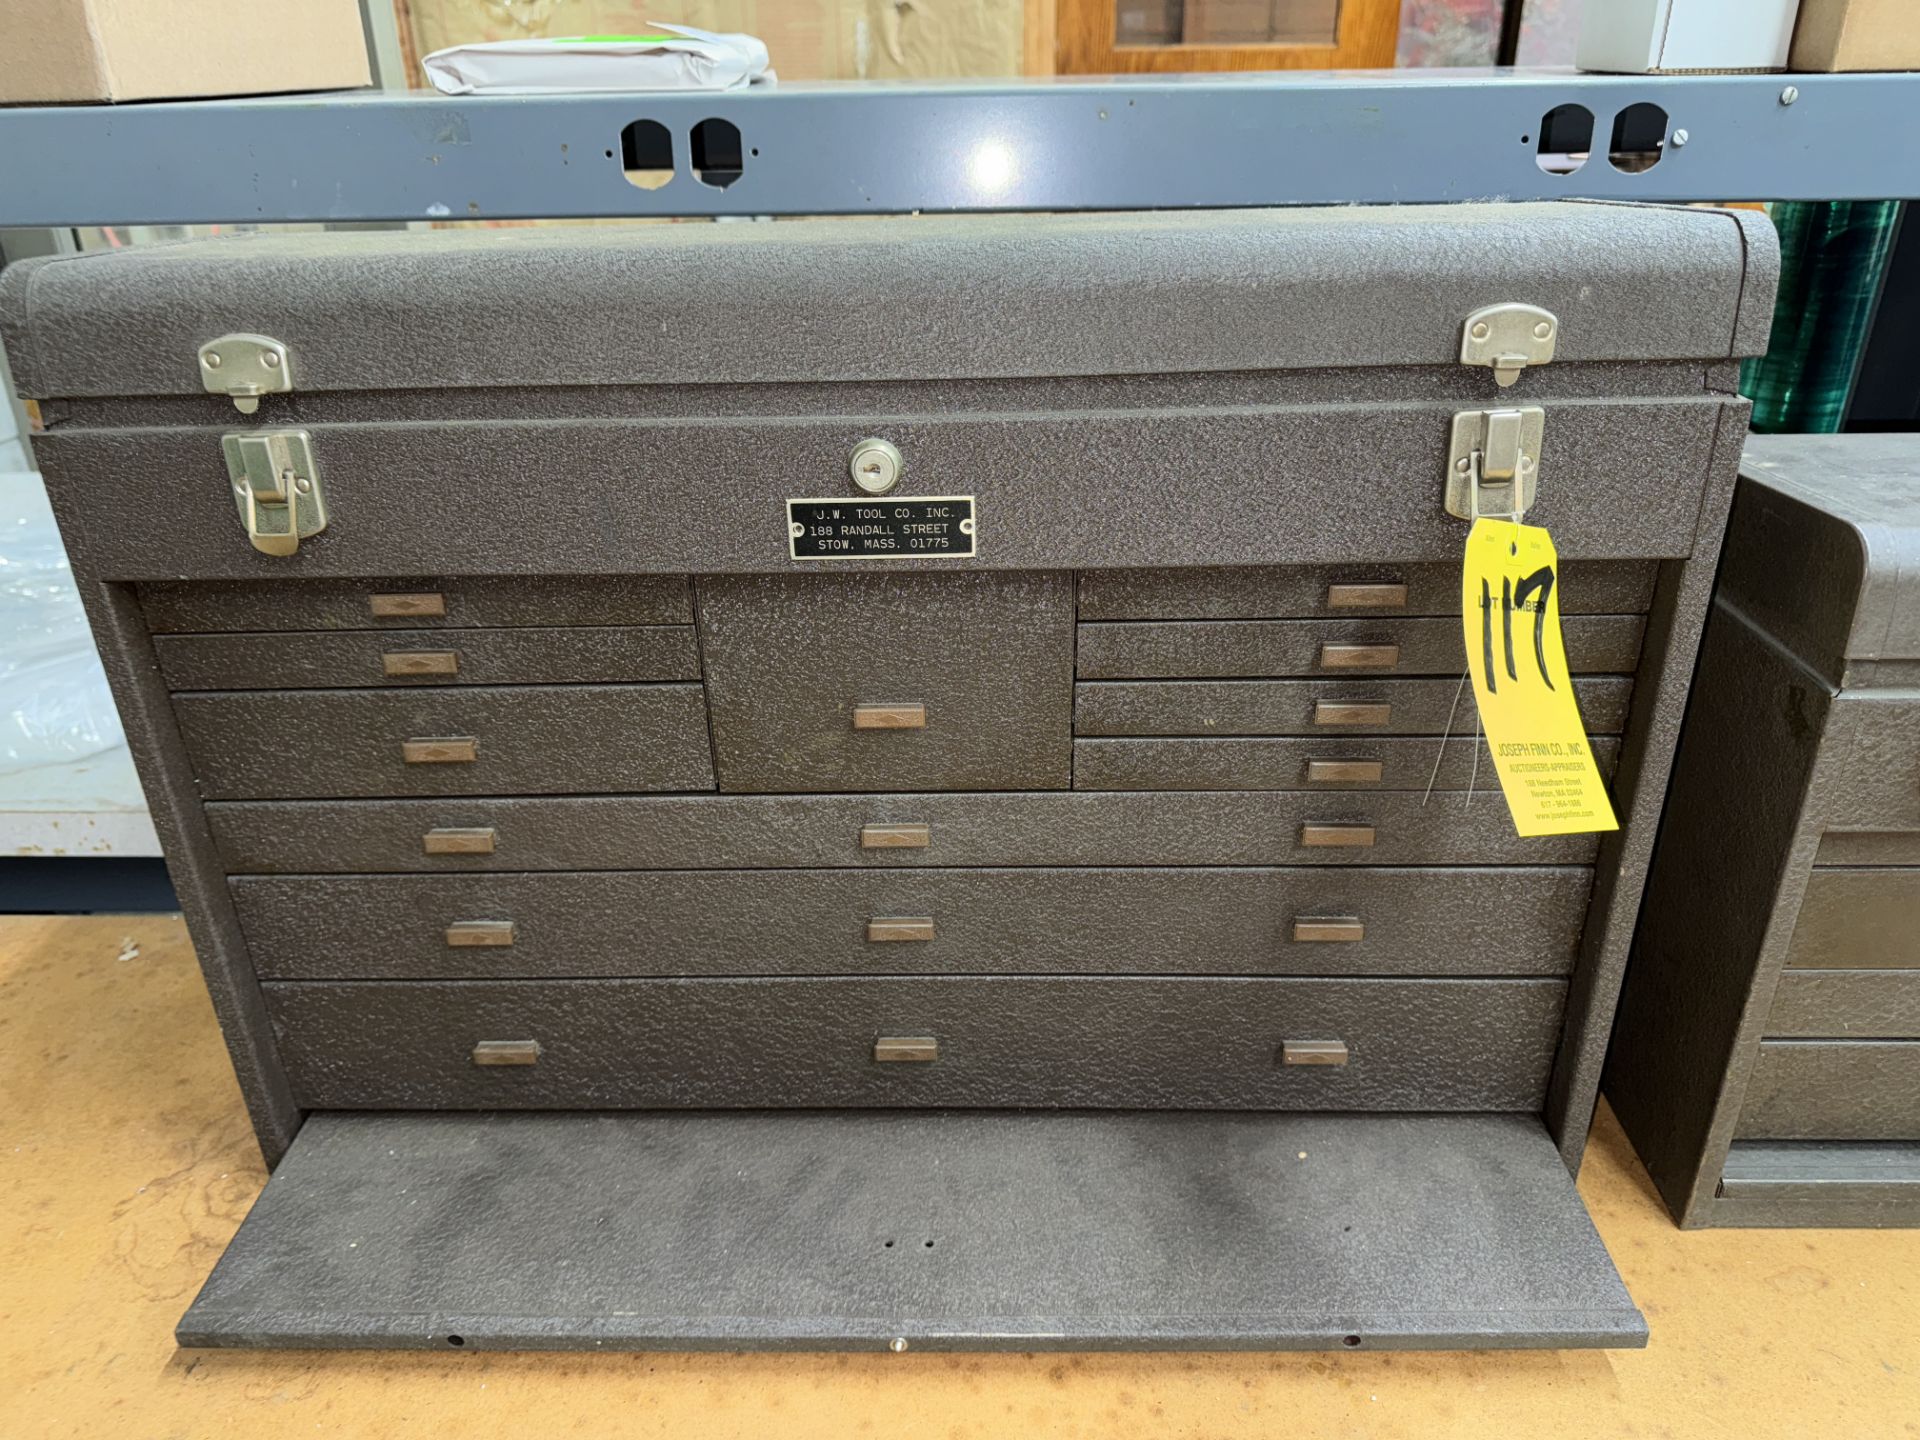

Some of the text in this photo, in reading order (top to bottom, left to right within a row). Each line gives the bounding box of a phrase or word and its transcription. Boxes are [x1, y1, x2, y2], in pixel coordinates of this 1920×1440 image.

[816, 507, 956, 520] J.W. TOOL CO. INC.
[810, 524, 949, 536] 188 RANDALL STREET
[864, 538, 901, 549] MASS.
[910, 538, 949, 548] 01775
[1482, 565, 1555, 694] 117
[1498, 743, 1529, 757] JOSEPH
[1531, 743, 1550, 756] FINN
[1568, 742, 1586, 756] INC.
[1556, 789, 1566, 797] MA
